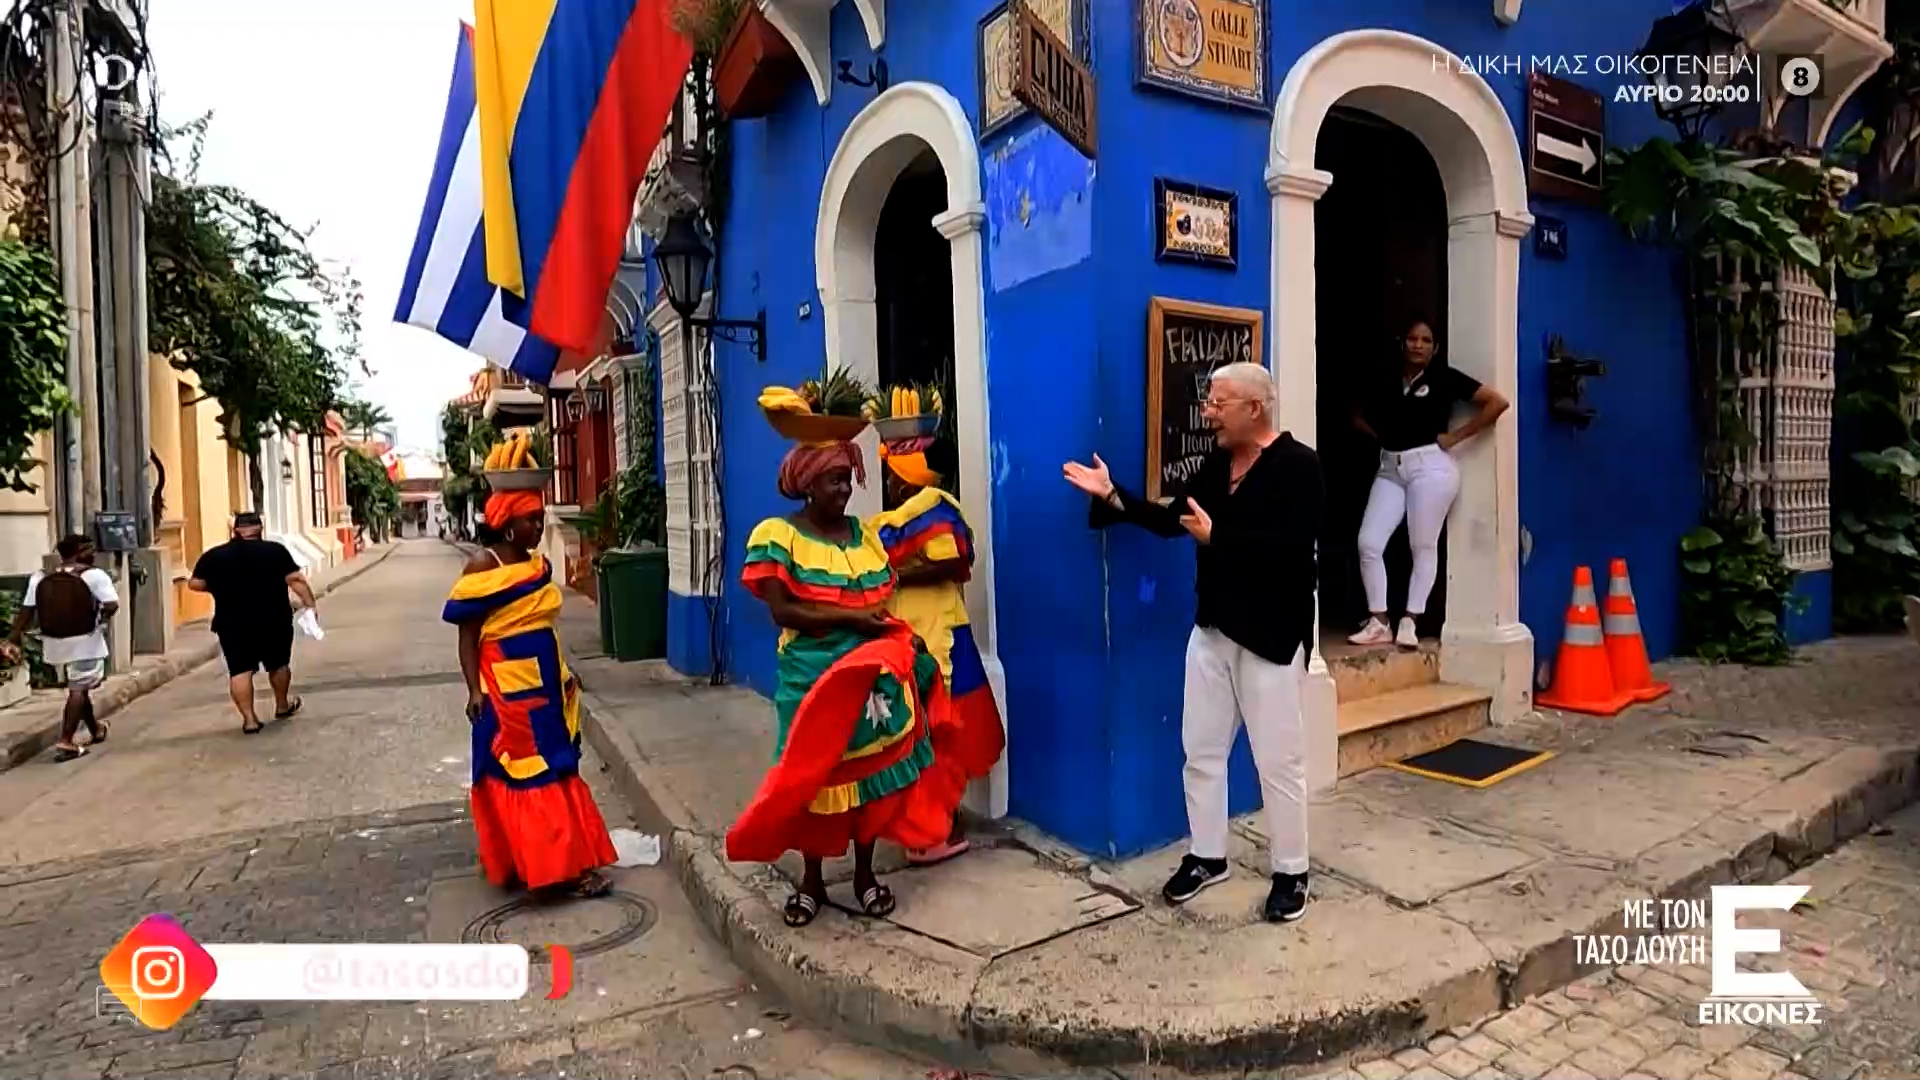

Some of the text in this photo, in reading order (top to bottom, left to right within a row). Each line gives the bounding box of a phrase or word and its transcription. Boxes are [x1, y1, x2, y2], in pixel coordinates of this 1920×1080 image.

[1210, 8, 1249, 39] CALLE
[1207, 40, 1252, 72] STUART
[1030, 25, 1088, 129] CUBA
